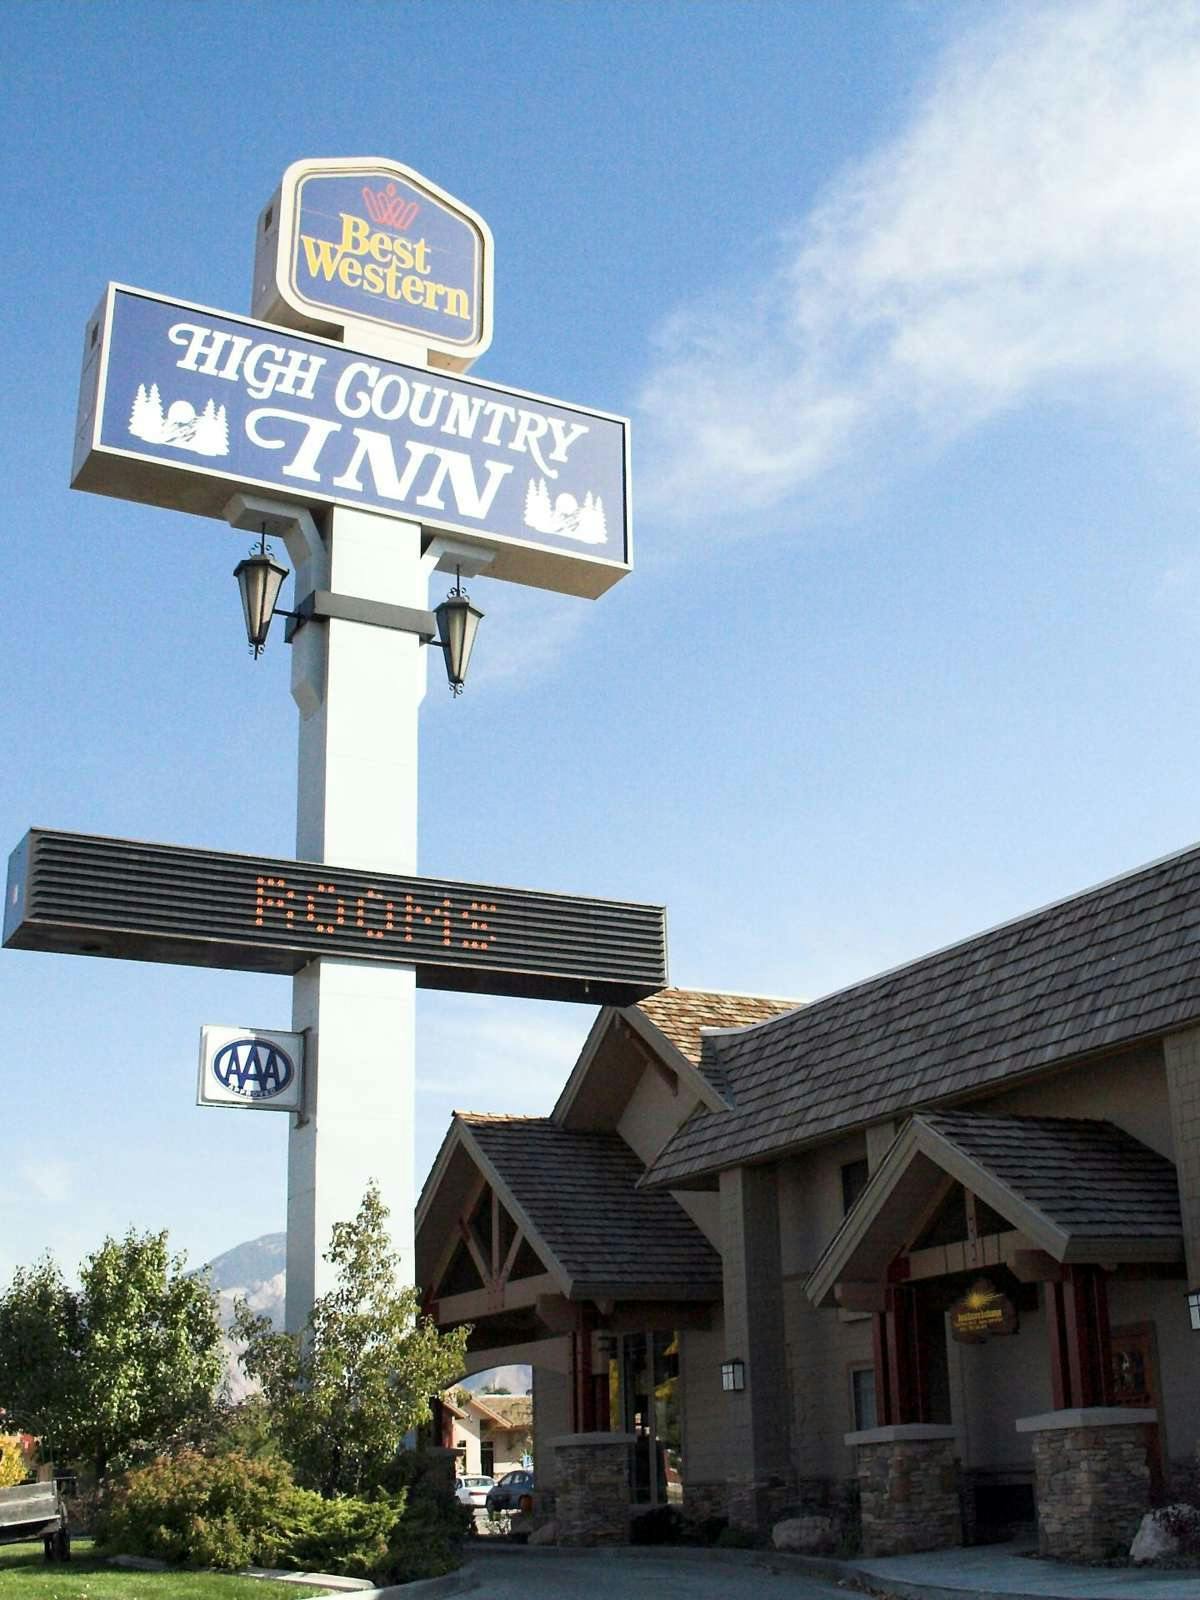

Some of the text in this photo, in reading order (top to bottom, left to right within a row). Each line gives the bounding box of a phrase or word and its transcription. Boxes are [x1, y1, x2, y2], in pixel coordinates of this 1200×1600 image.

[300, 235, 471, 320] Western
[339, 213, 431, 275] Best
[168, 322, 589, 479] HIGH COUNTRY
[245, 407, 514, 519] INN
[256, 876, 497, 950] ROOMS
[225, 1041, 281, 1091] AAA
